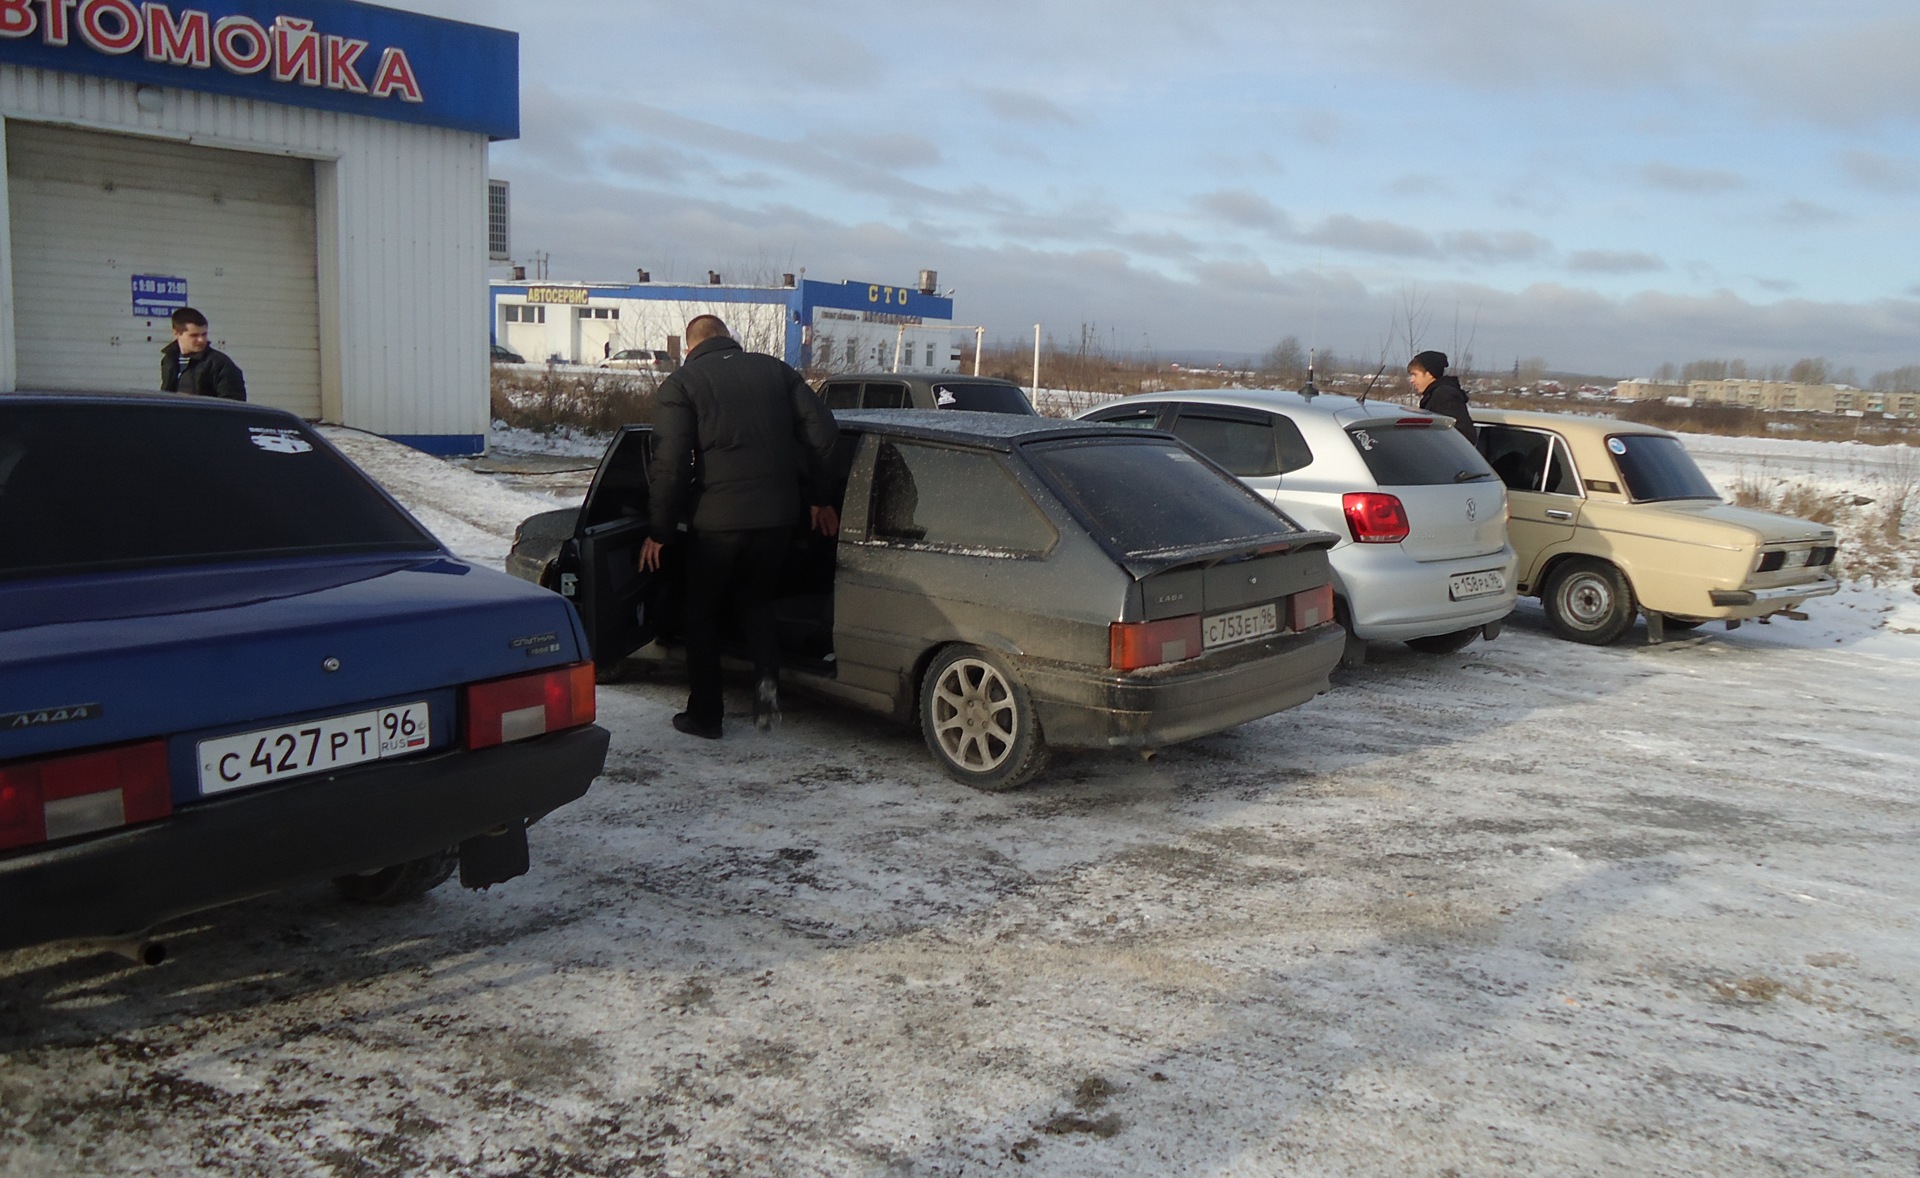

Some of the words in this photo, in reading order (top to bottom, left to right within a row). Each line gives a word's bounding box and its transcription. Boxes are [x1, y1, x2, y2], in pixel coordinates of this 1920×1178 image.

[527, 288, 588, 304] АВТОСЕРВИС
[868, 284, 908, 306] СТО
[11, 707, 88, 727] ЛАДА
[383, 709, 416, 740] 96
[381, 739, 406, 753] RUS
